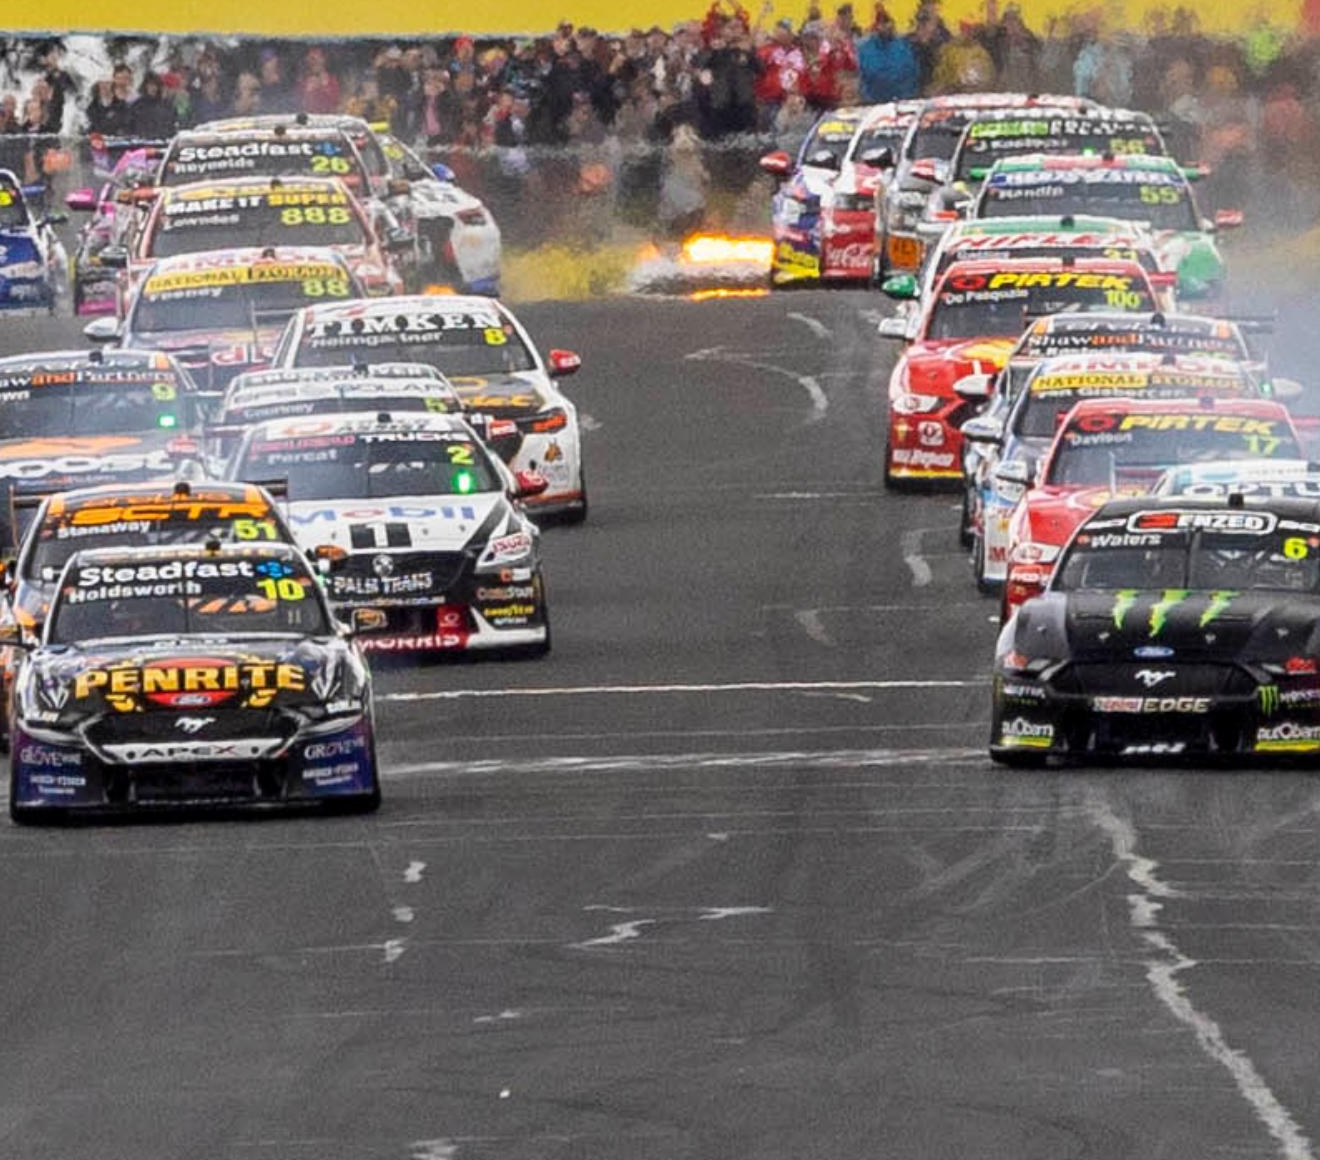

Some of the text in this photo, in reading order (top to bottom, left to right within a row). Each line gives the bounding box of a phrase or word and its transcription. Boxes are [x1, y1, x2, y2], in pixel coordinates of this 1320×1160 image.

[180, 142, 315, 161] Steadfast
[311, 156, 351, 173] 26
[166, 192, 347, 215] MAKE IT SUPER
[281, 207, 351, 225] 888
[302, 278, 350, 297] 88
[990, 272, 1135, 291] PIRTEK
[1104, 290, 1141, 308] 100
[307, 313, 502, 339] TIMKEN
[484, 328, 509, 346] 8
[1036, 376, 1144, 389] NATIONAL
[1119, 414, 1280, 435] PIRTEK
[1242, 434, 1280, 456] 17
[447, 445, 475, 465] 2
[233, 519, 278, 540] 51
[1177, 513, 1265, 531] ENZED
[366, 522, 390, 548] 1
[1091, 534, 1162, 549] Waters
[1284, 537, 1309, 560] 6
[78, 560, 256, 587] Steadfast
[69, 580, 203, 604] Holdsworth
[257, 578, 306, 601] 10
[74, 662, 306, 700] PENRITE
[1143, 697, 1212, 713] EDGE
[141, 744, 237, 759] APEX
